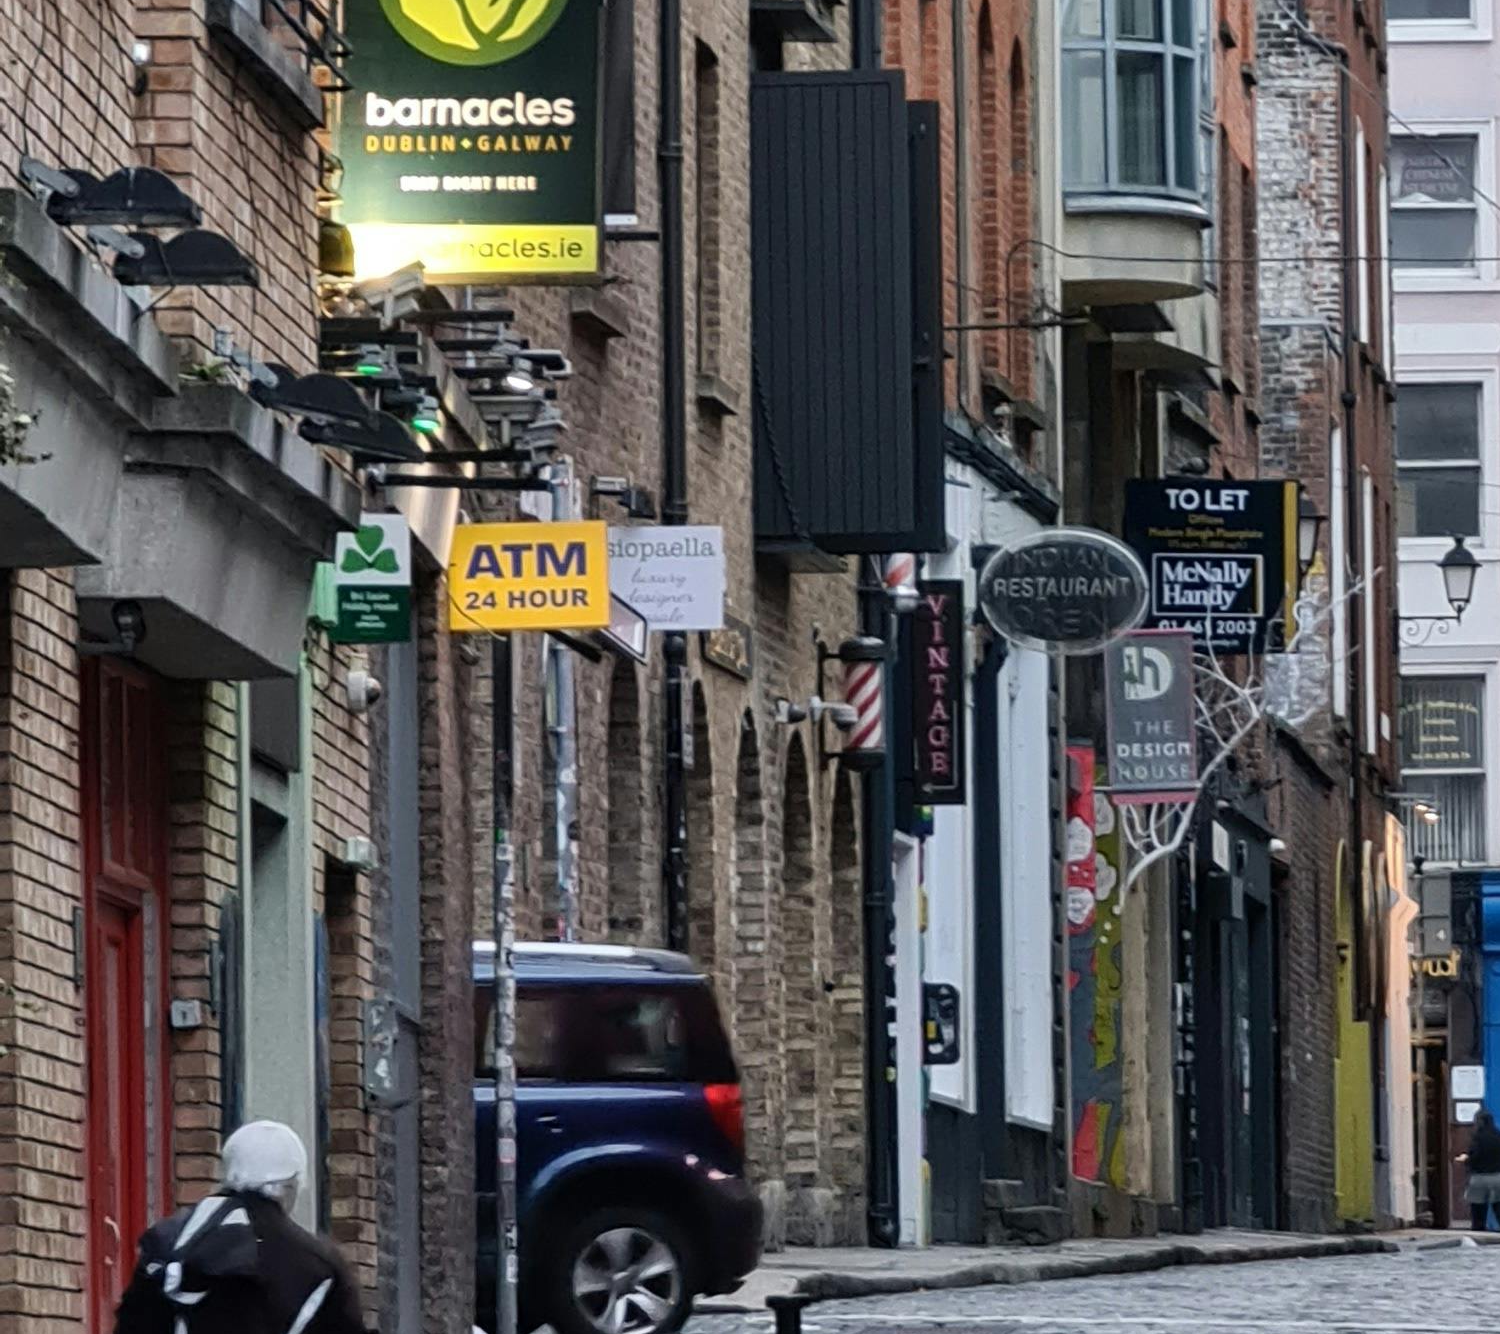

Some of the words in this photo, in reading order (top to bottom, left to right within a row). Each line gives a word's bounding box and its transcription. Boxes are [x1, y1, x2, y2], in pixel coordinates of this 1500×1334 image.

[366, 91, 576, 127] barnacles
[365, 134, 456, 153] DUBLIN
[477, 134, 573, 152] GALWAY
[496, 175, 538, 192] HERE
[1165, 488, 1200, 511] TO
[1204, 489, 1249, 511] LET
[465, 542, 587, 580] ATM
[1162, 560, 1252, 588] McNally
[993, 577, 1131, 598] RESTAURANT
[1162, 583, 1237, 611] Handy
[465, 592, 497, 610] 24
[508, 588, 589, 609] HOUR
[926, 594, 950, 774] VINTAGE
[1134, 720, 1174, 736] THE
[1116, 741, 1191, 758] DESIGN
[1117, 763, 1189, 781] HOUSE
